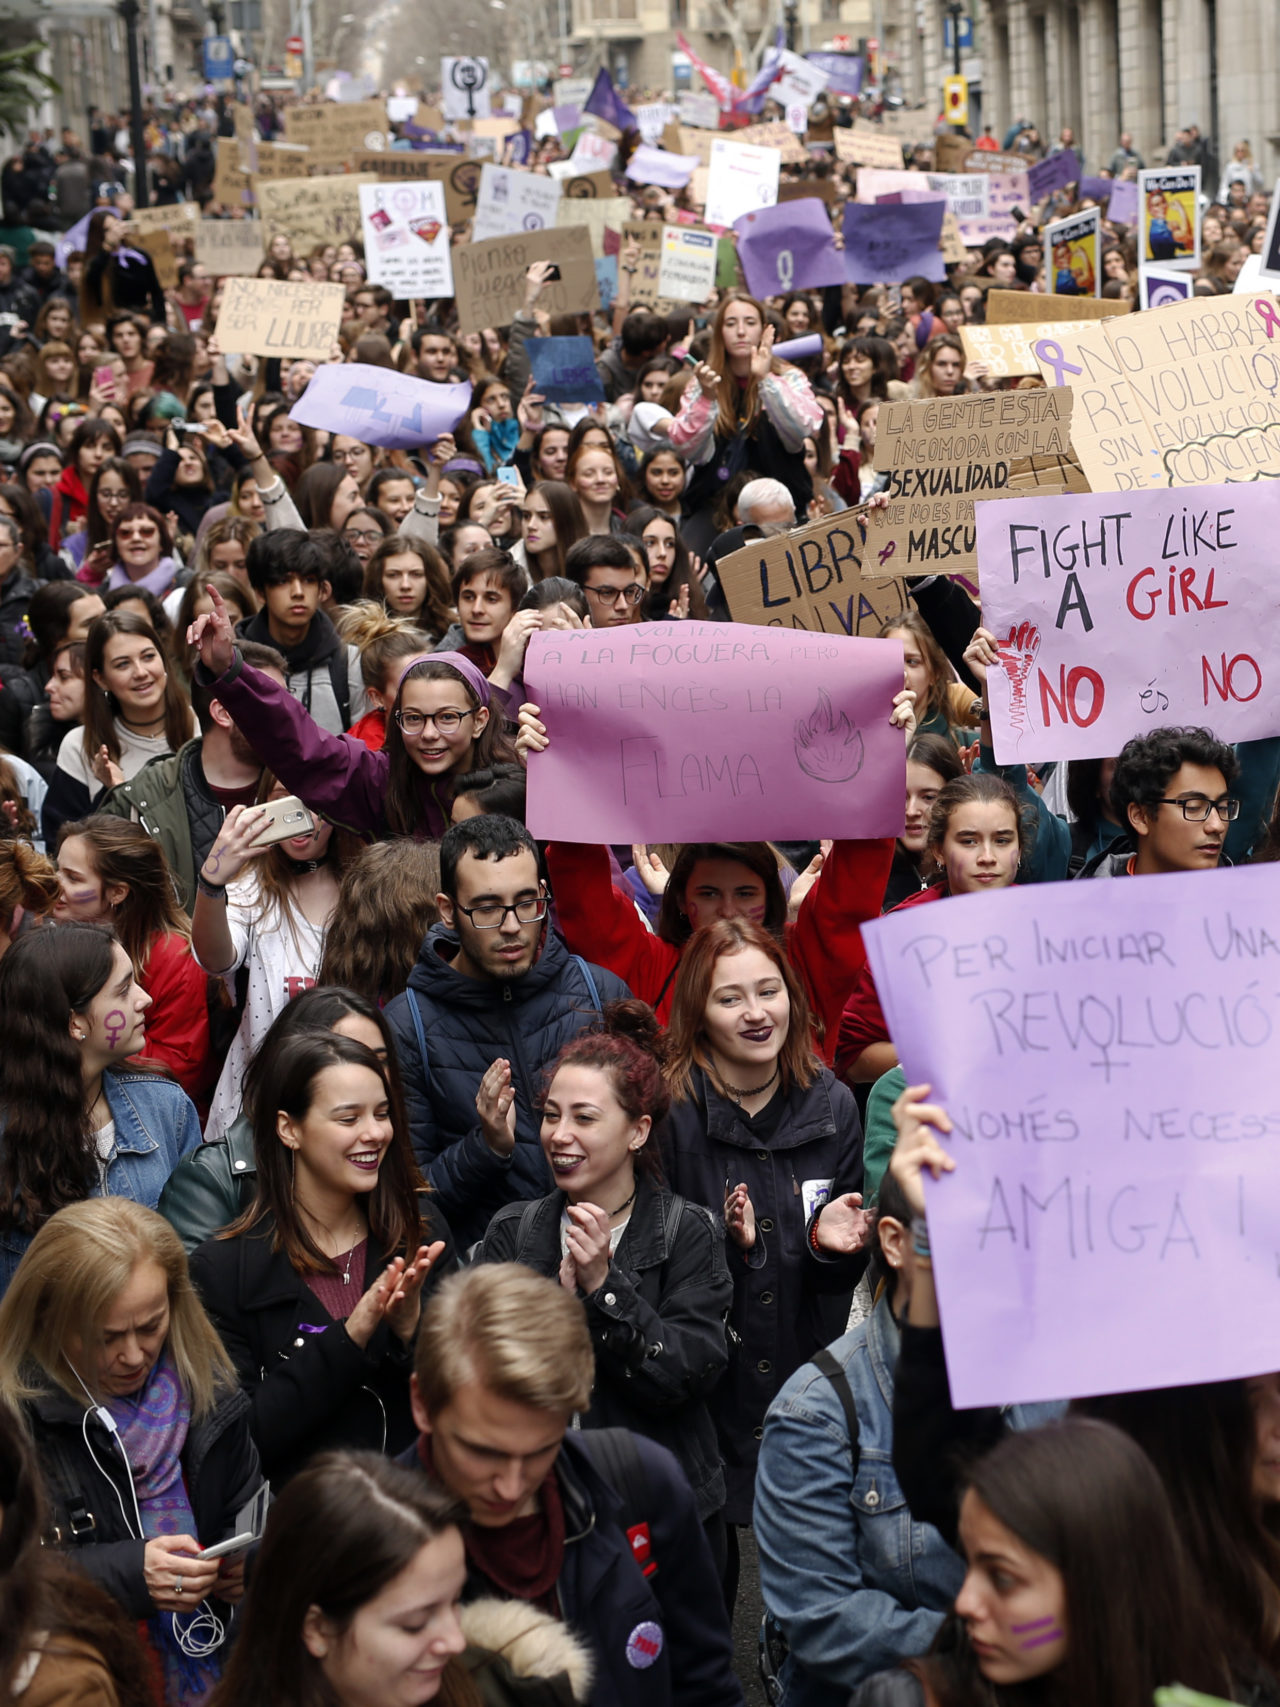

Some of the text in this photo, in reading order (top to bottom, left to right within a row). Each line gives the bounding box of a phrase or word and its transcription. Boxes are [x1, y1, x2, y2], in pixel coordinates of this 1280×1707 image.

[1077, 335, 1145, 383] NO
[1159, 298, 1273, 361] HABRÁ
[886, 391, 1060, 435] LA GENTE ESTA
[893, 427, 1064, 466] INCOMODA CON LA
[1100, 433, 1143, 466] SIN
[891, 461, 1008, 499] SEXUALIDAD
[1115, 467, 1148, 492] DE
[874, 500, 975, 528] QUE NO ES PA
[760, 508, 867, 609] LIBR
[907, 525, 976, 563] MASCU
[1009, 512, 1132, 584] FIGHT
[1055, 572, 1094, 632] A
[543, 650, 562, 664] A
[580, 648, 614, 664] LA
[629, 642, 778, 668] FOGUERA,
[544, 681, 783, 713] HAN ENCÈS LA
[1038, 652, 1262, 728] NO és NO
[620, 735, 764, 805] FLAMA
[899, 934, 1016, 988] PER
[970, 980, 1272, 1083] REVOLUCIÓ
[949, 1093, 1080, 1142] NOMÉS
[976, 1172, 1201, 1261] AMIGA
